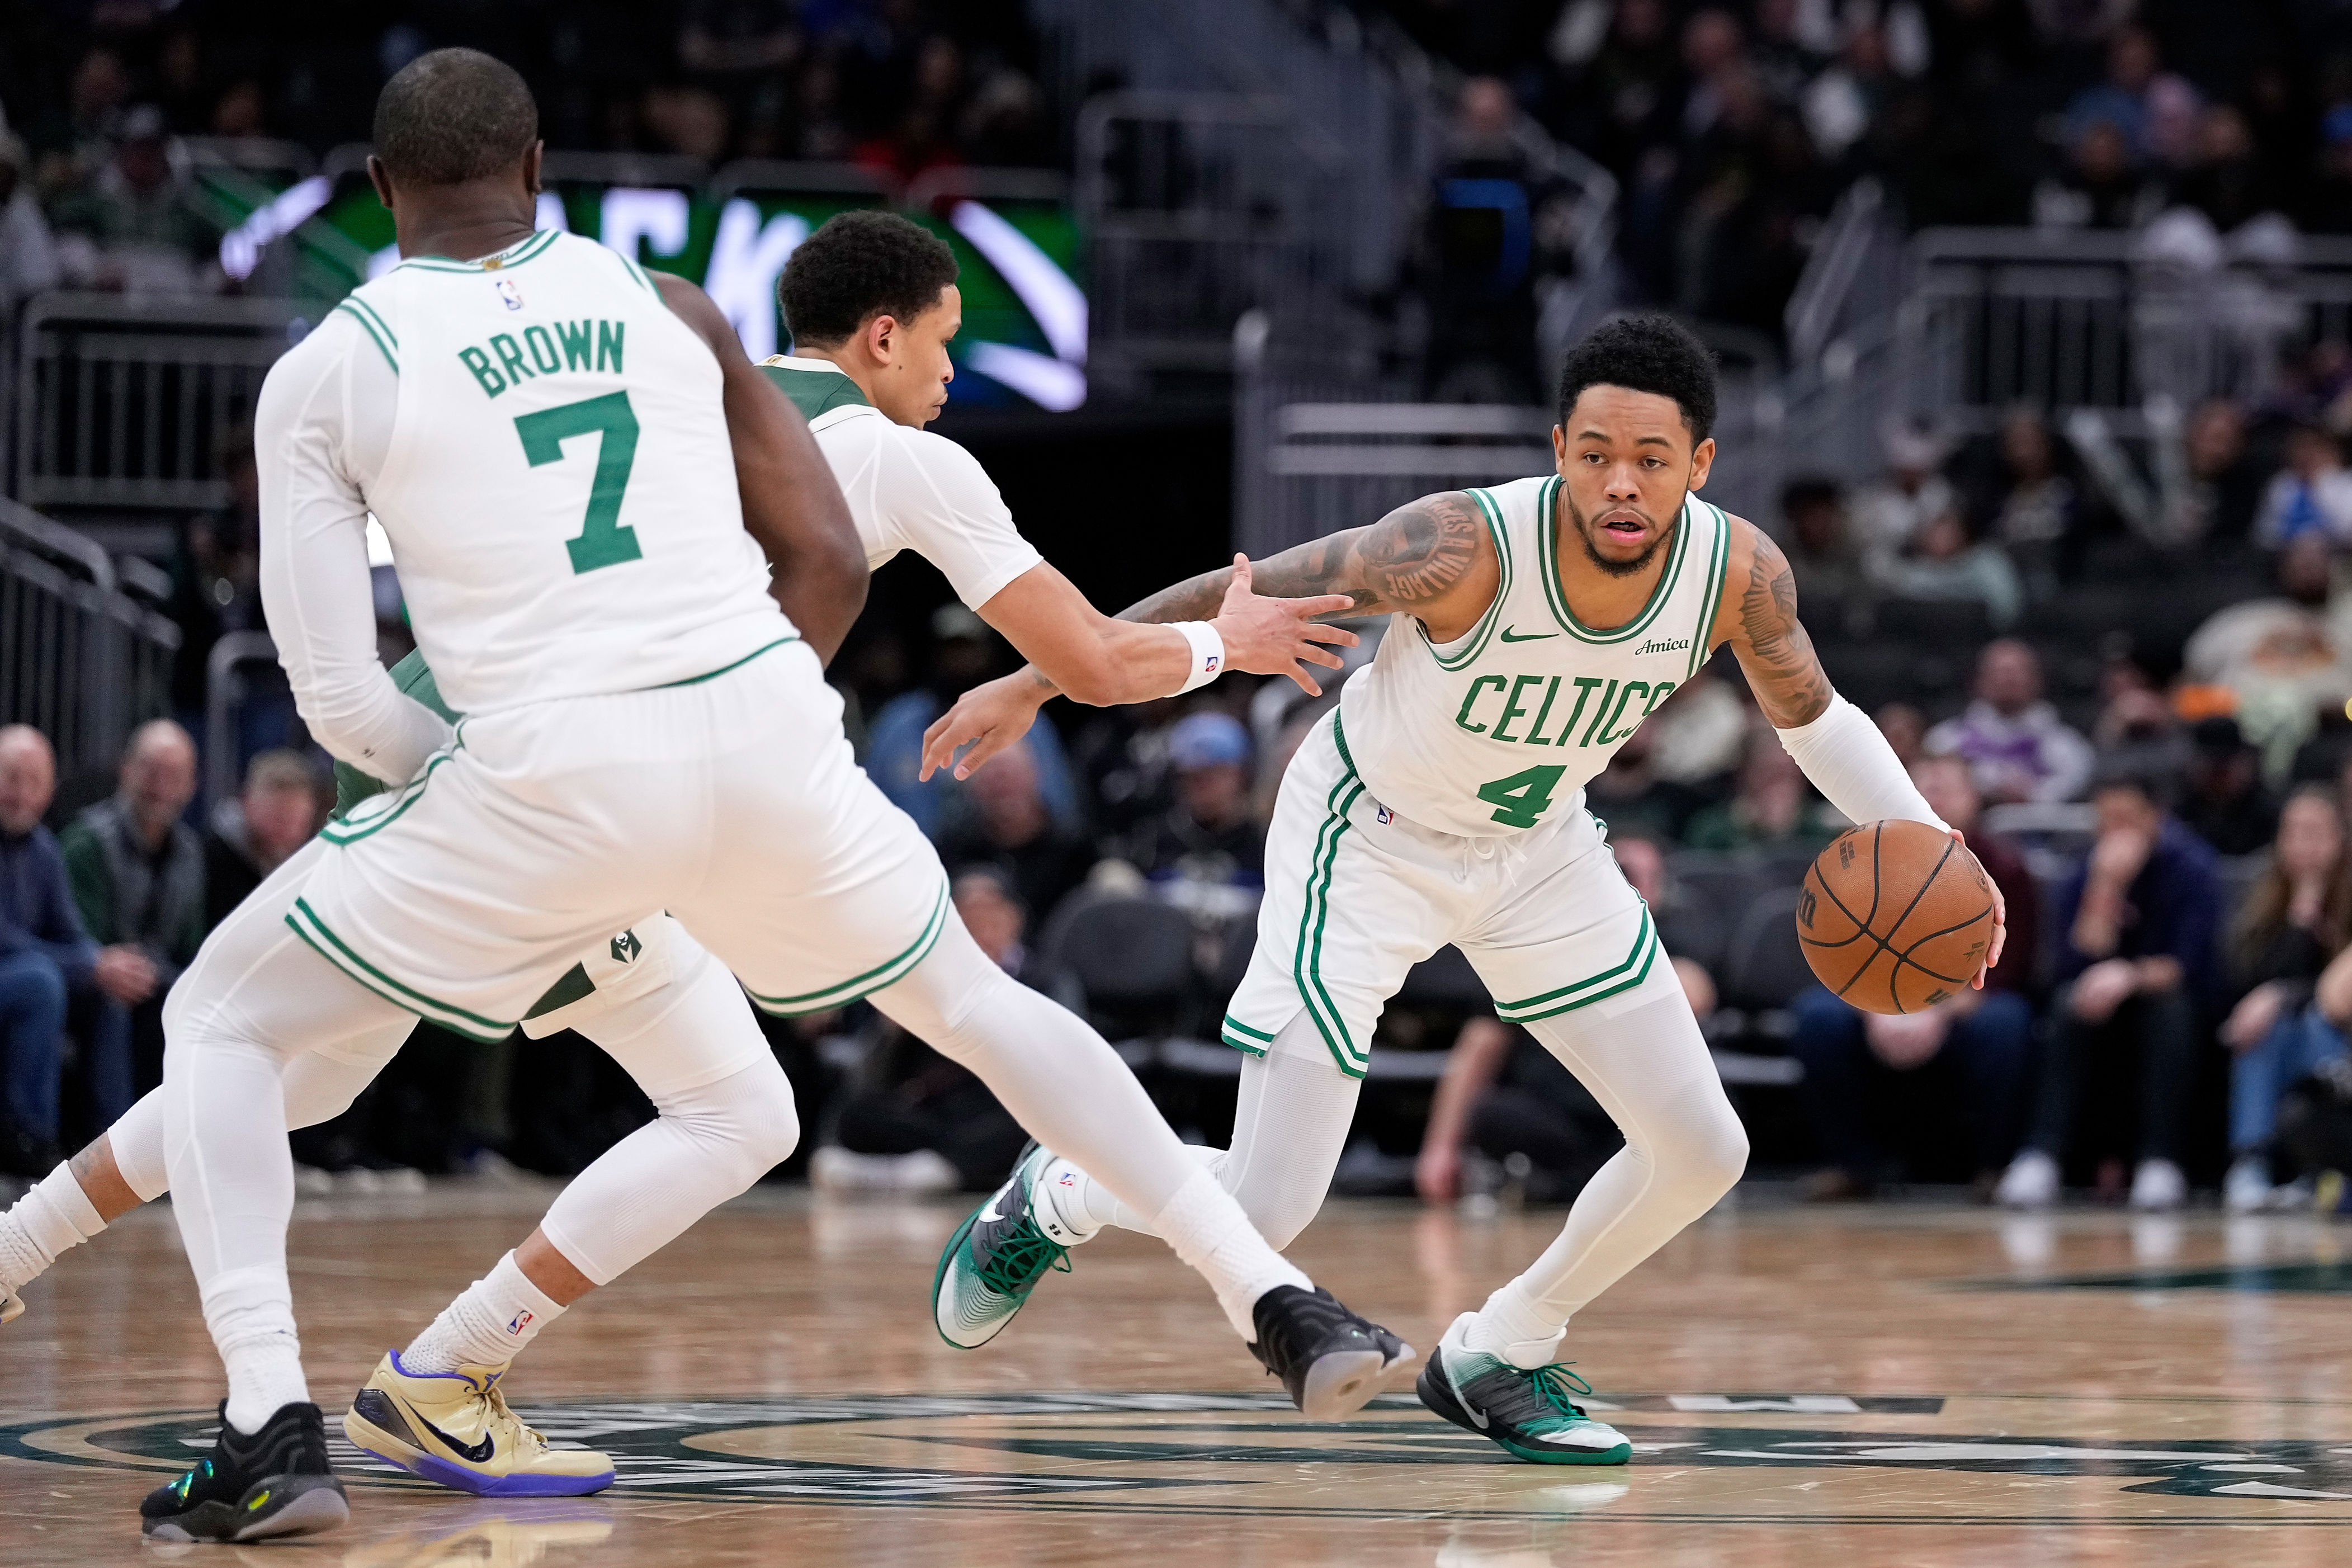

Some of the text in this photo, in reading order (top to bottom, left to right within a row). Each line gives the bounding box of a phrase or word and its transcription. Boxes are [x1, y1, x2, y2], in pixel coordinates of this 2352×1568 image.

[457, 319, 625, 399] BROWN
[513, 389, 643, 575] 7
[1385, 551, 1470, 600] VILLAGE
[1635, 638, 1689, 655] Amica
[1476, 764, 1567, 829] 4
